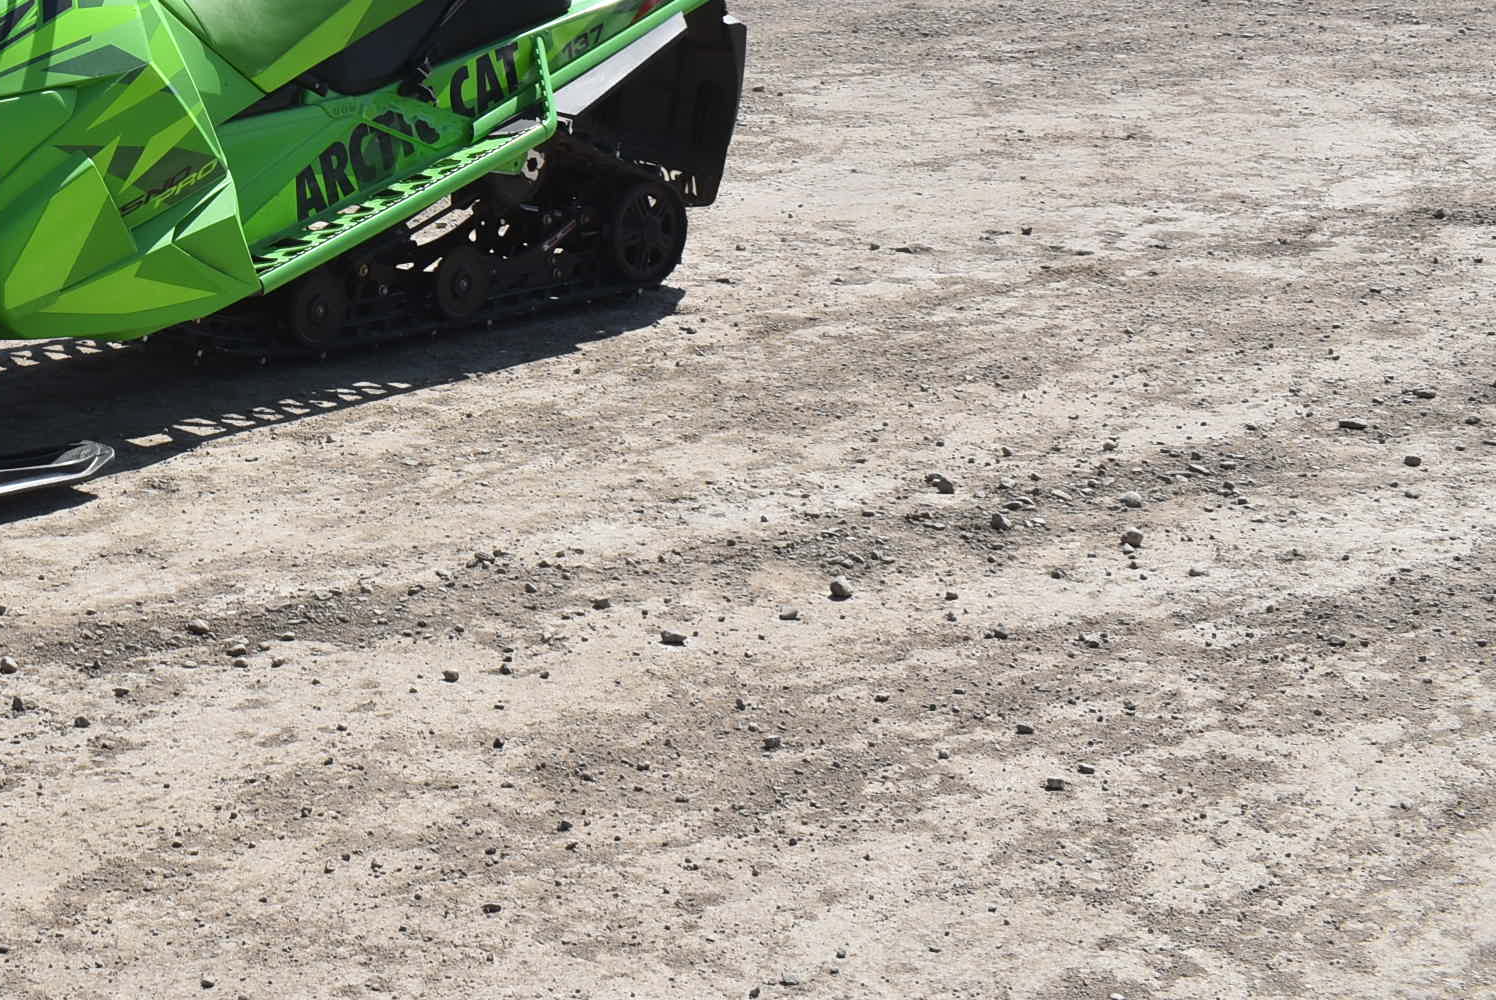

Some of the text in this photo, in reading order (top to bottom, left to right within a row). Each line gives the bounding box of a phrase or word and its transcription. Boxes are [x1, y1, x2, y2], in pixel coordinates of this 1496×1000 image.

[562, 23, 604, 60] 137
[450, 41, 520, 117] CAT
[152, 159, 218, 209] PRO
